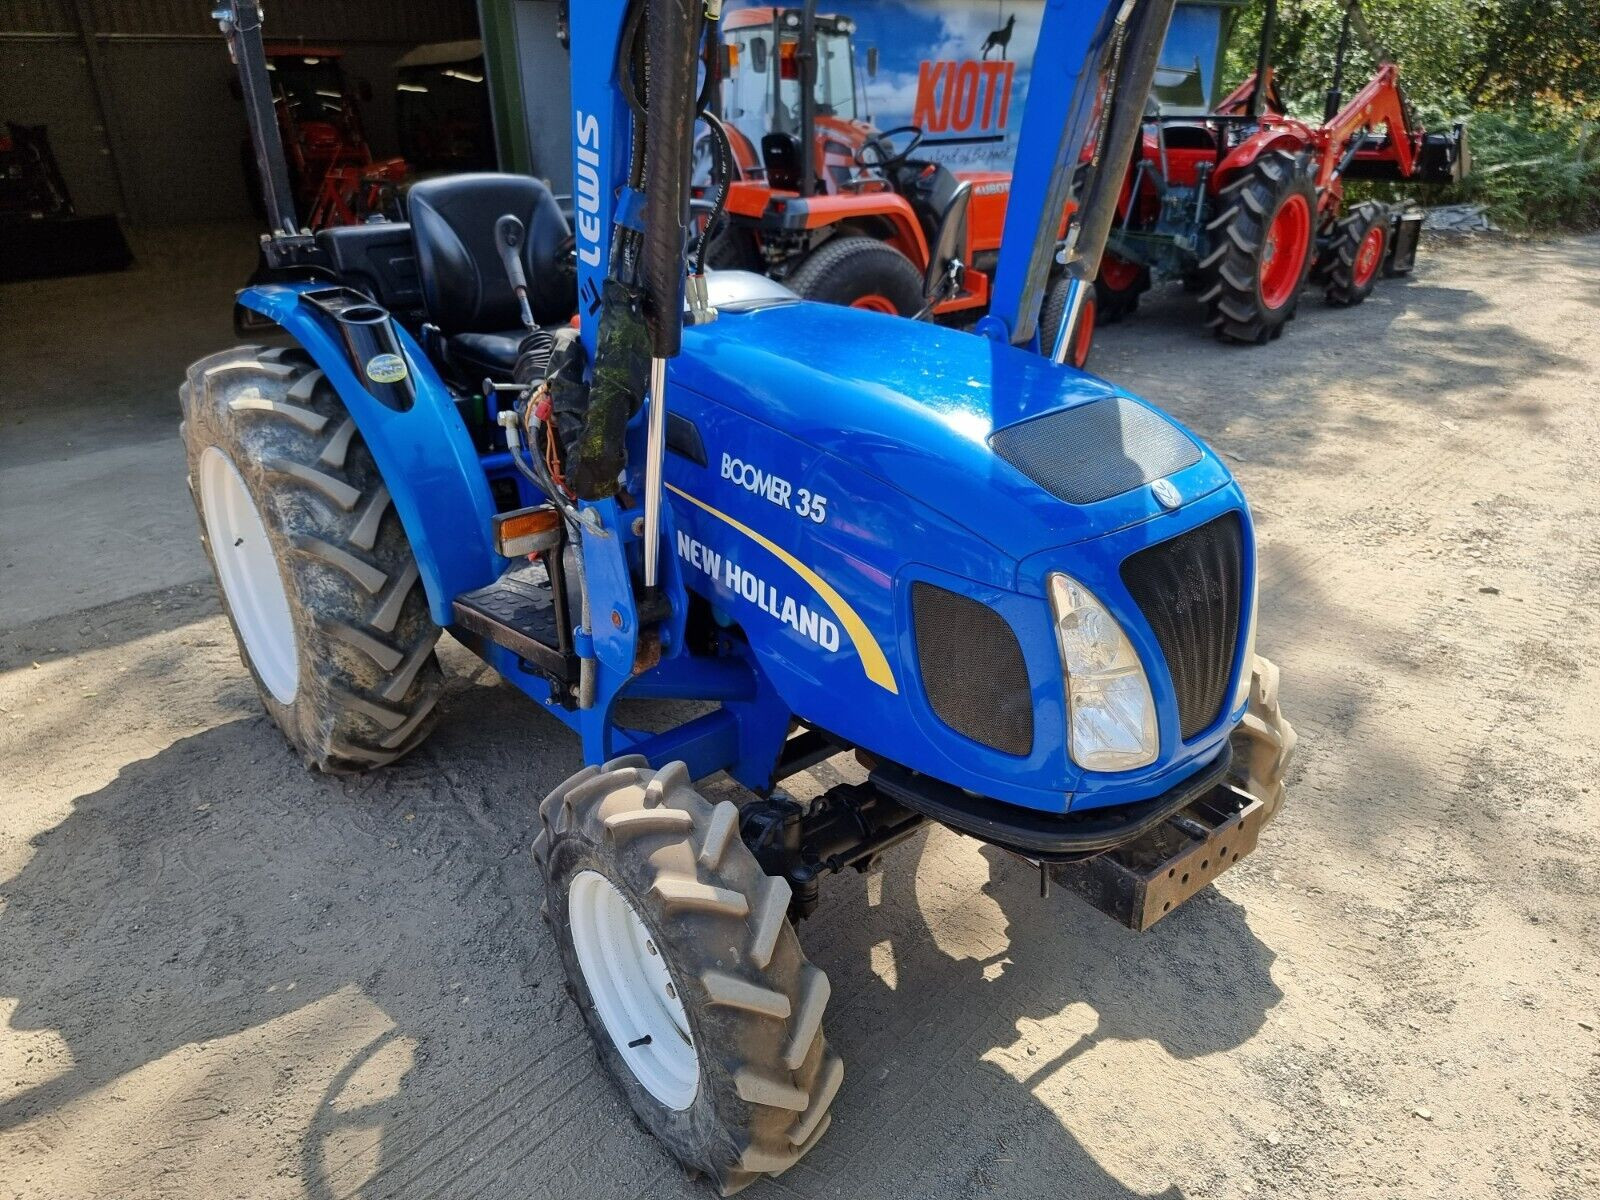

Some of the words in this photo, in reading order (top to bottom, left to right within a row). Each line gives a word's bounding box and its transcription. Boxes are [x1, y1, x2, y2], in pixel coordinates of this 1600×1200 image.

[912, 59, 1015, 134] KIOTI
[576, 111, 600, 267] LEWIS
[975, 183, 1011, 196] KUBOT
[720, 452, 791, 510] BOOMER
[795, 488, 827, 524] 35
[677, 530, 721, 580] NEW
[725, 559, 840, 653] HOLLAND
